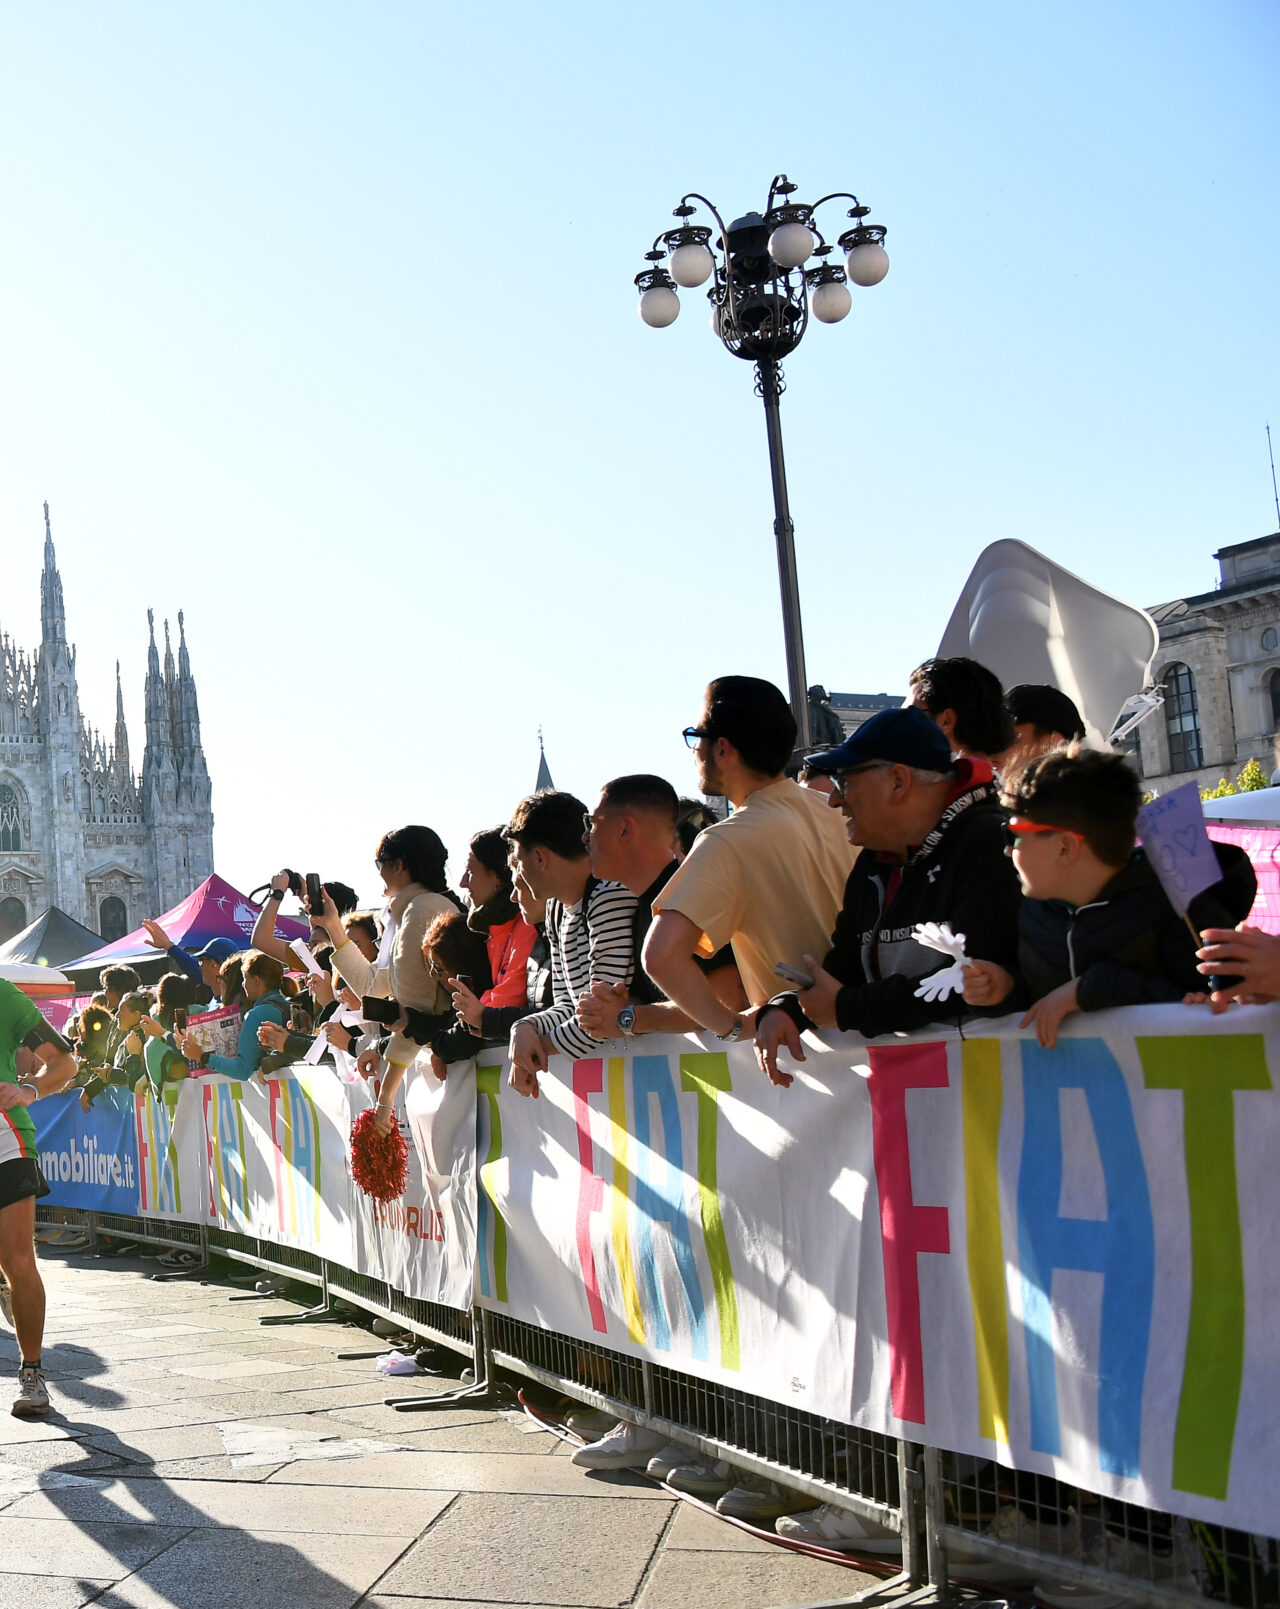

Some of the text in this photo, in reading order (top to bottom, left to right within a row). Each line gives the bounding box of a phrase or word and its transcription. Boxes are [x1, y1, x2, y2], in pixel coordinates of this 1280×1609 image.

[38, 1135, 135, 1189] mobiliare.it
[135, 1088, 182, 1214] FIAT
[203, 1083, 251, 1224] FIAT
[269, 1078, 321, 1243] FIAT
[573, 1051, 741, 1372] FIAT
[867, 1032, 1272, 1501] FIAT
